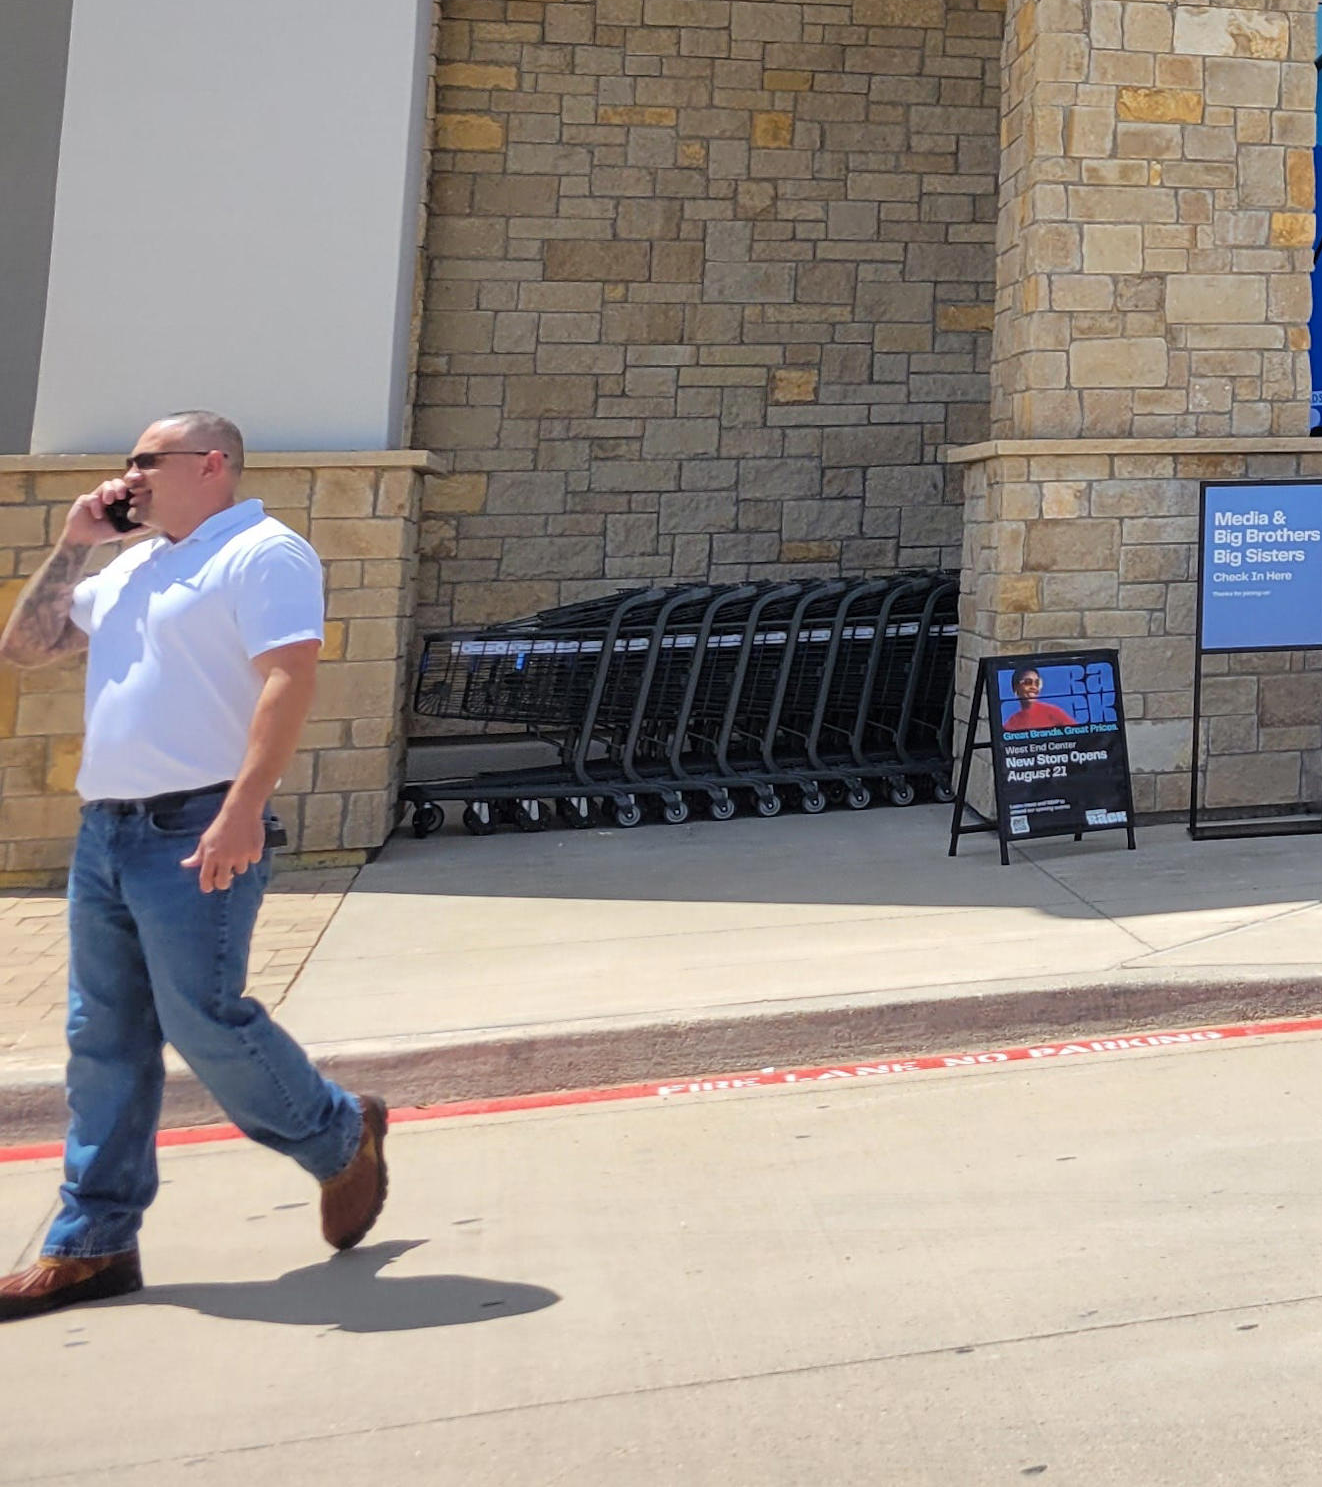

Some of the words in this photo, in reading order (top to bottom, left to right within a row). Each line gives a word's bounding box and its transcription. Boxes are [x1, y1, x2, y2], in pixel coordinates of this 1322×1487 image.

[1214, 510, 1269, 526] Media
[1272, 510, 1287, 525] &
[1213, 529, 1242, 547] Big
[1245, 527, 1321, 543] Brothers
[1213, 549, 1242, 567] Big
[1245, 548, 1305, 563] Sisters
[1213, 572, 1249, 583] Check
[1251, 572, 1264, 582] In
[1266, 571, 1293, 581] Here
[1003, 730, 1029, 741] Great
[1064, 726, 1089, 736] Great
[1005, 744, 1028, 755] West
[1029, 743, 1047, 753] End
[1048, 740, 1076, 751] Center
[1005, 756, 1035, 768] New
[1036, 753, 1068, 765] Store
[1070, 750, 1108, 764] Opens
[1007, 767, 1051, 783] August
[1052, 766, 1067, 777] 21
[658, 1076, 760, 1096] FIRE
[785, 1060, 919, 1083] LANE
[943, 1052, 1008, 1068] NO
[1028, 1029, 1224, 1059] PARKING
